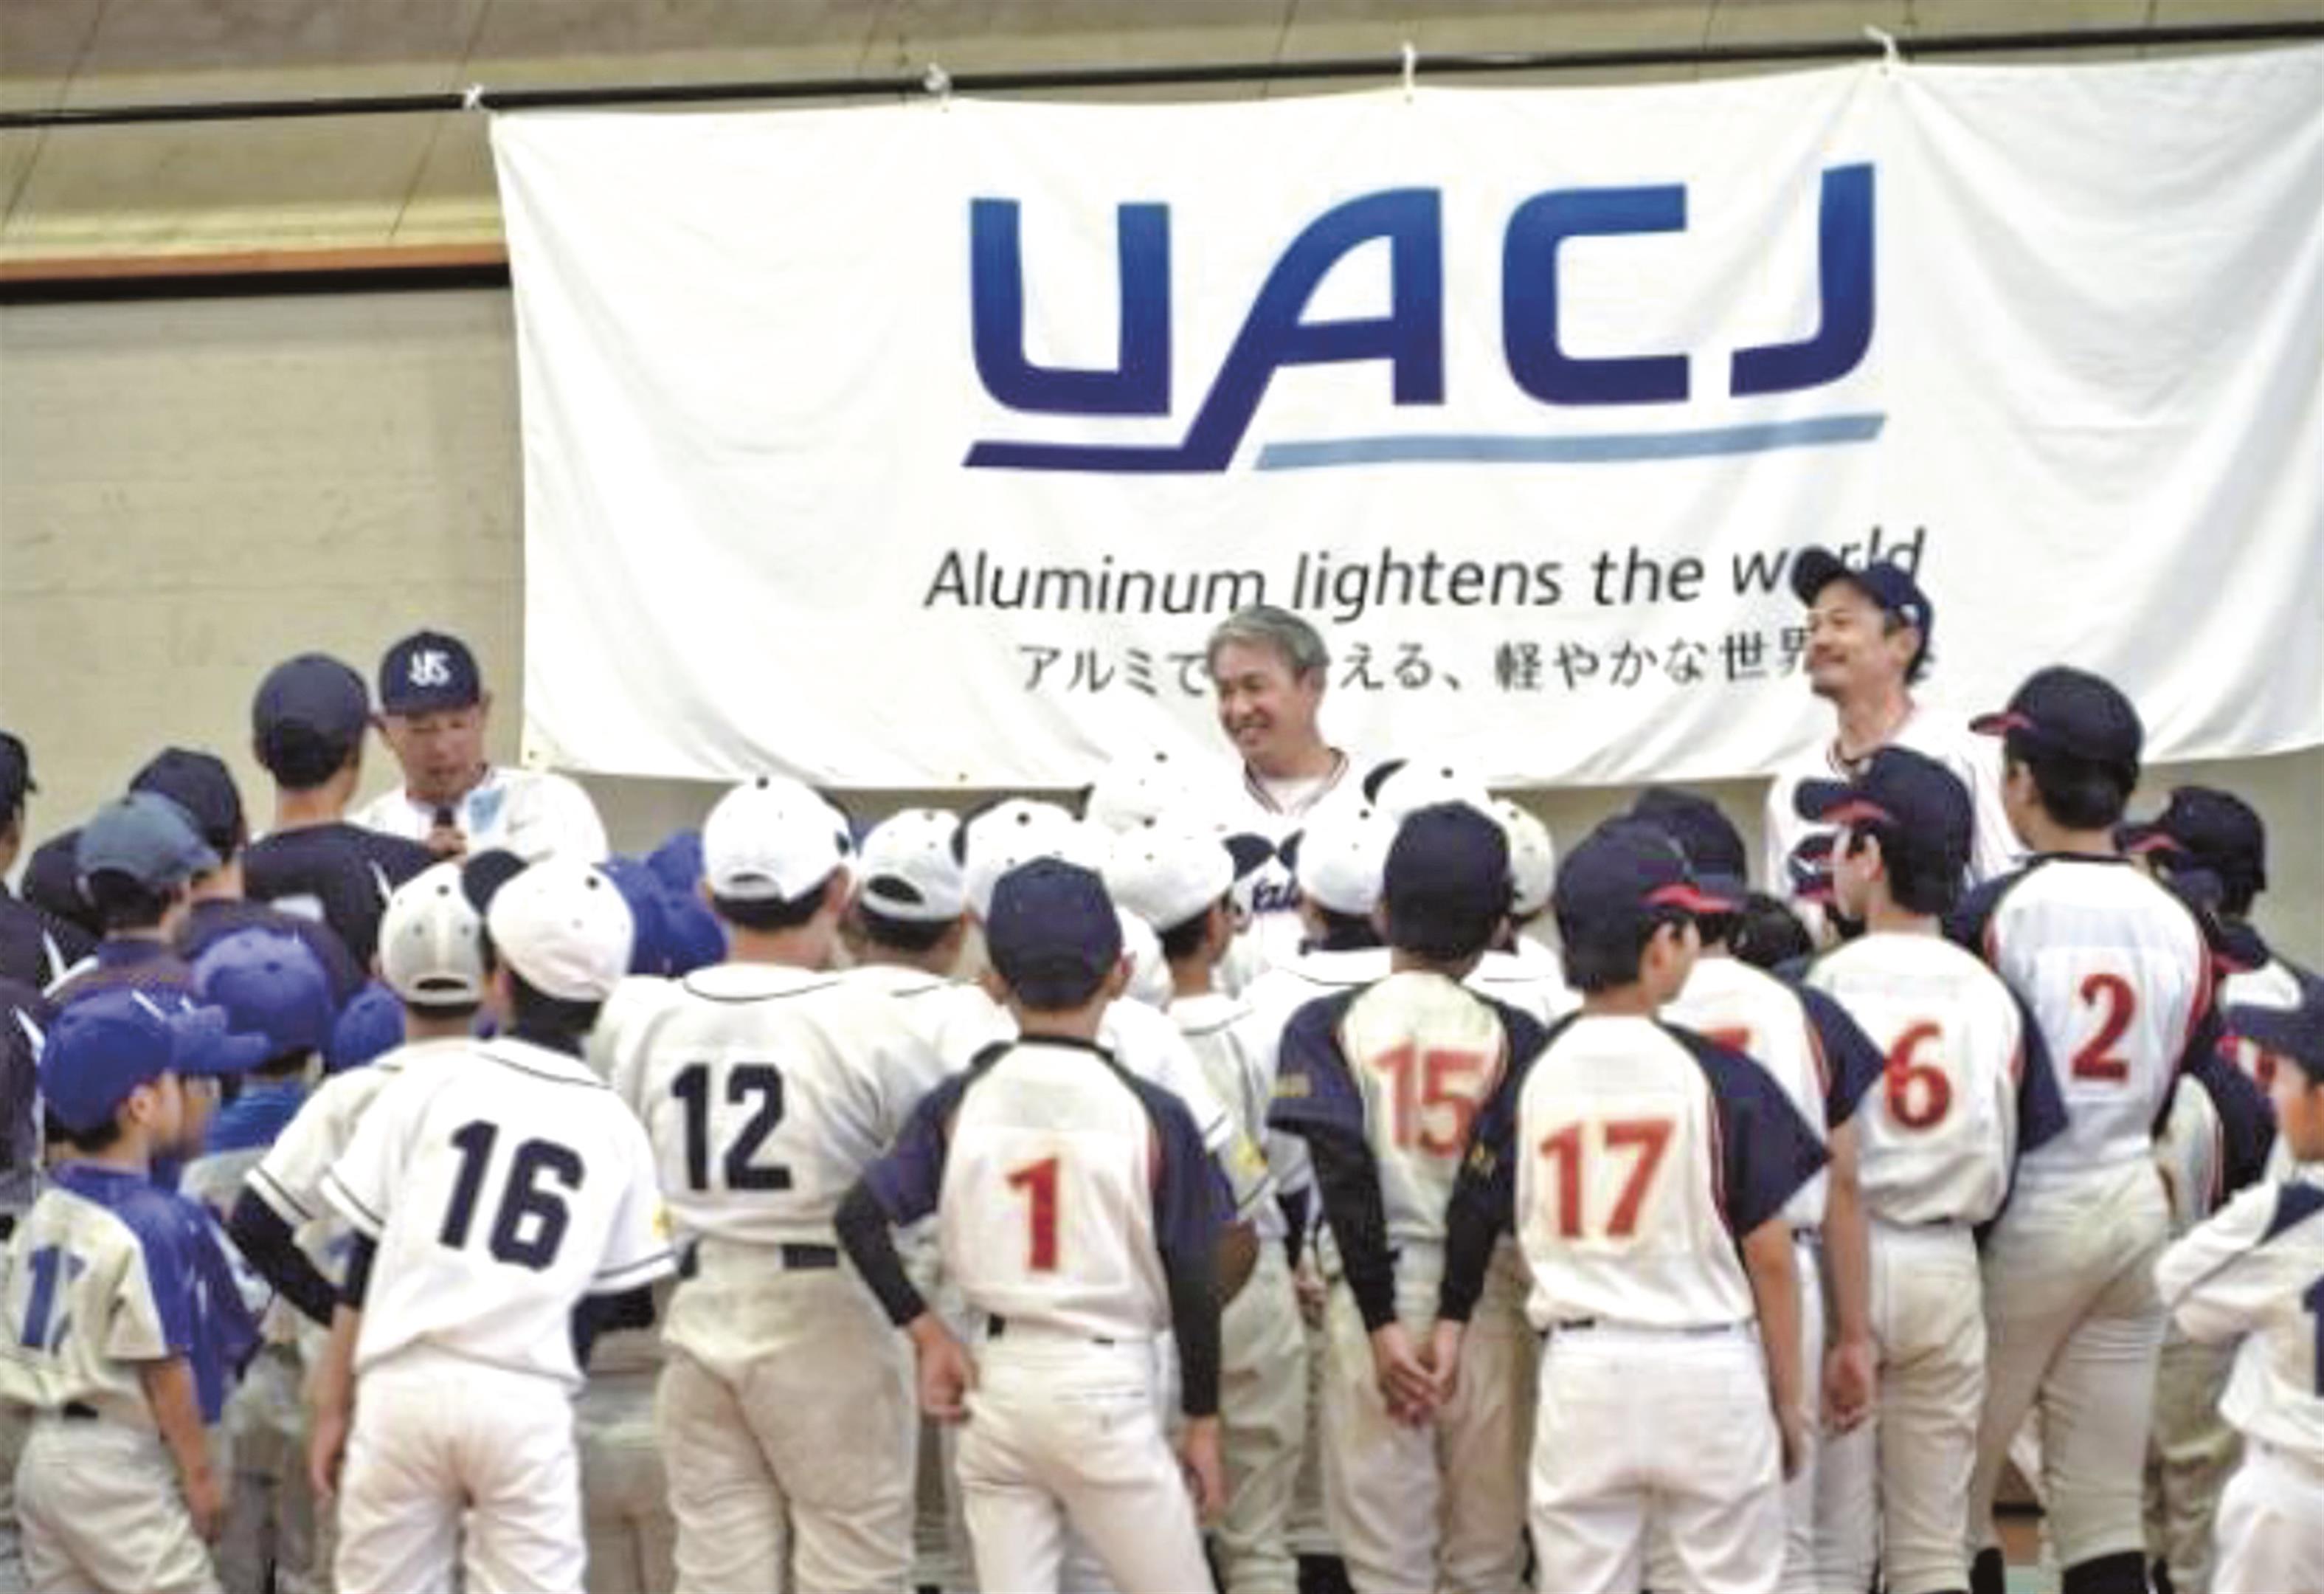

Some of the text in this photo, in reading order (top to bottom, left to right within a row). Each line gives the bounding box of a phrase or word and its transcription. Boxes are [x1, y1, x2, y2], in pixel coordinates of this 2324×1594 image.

[964, 162, 1878, 474] UACJ
[922, 525, 1926, 623] Aluminum lightens the wrld
[1885, 1021, 1952, 1129] 6
[2072, 973, 2137, 1082] 2
[671, 1063, 792, 1191] 12
[1372, 1042, 1486, 1159] 15
[438, 1119, 586, 1272] 16
[1009, 1156, 1058, 1272] 1
[1540, 1119, 1673, 1240] 17
